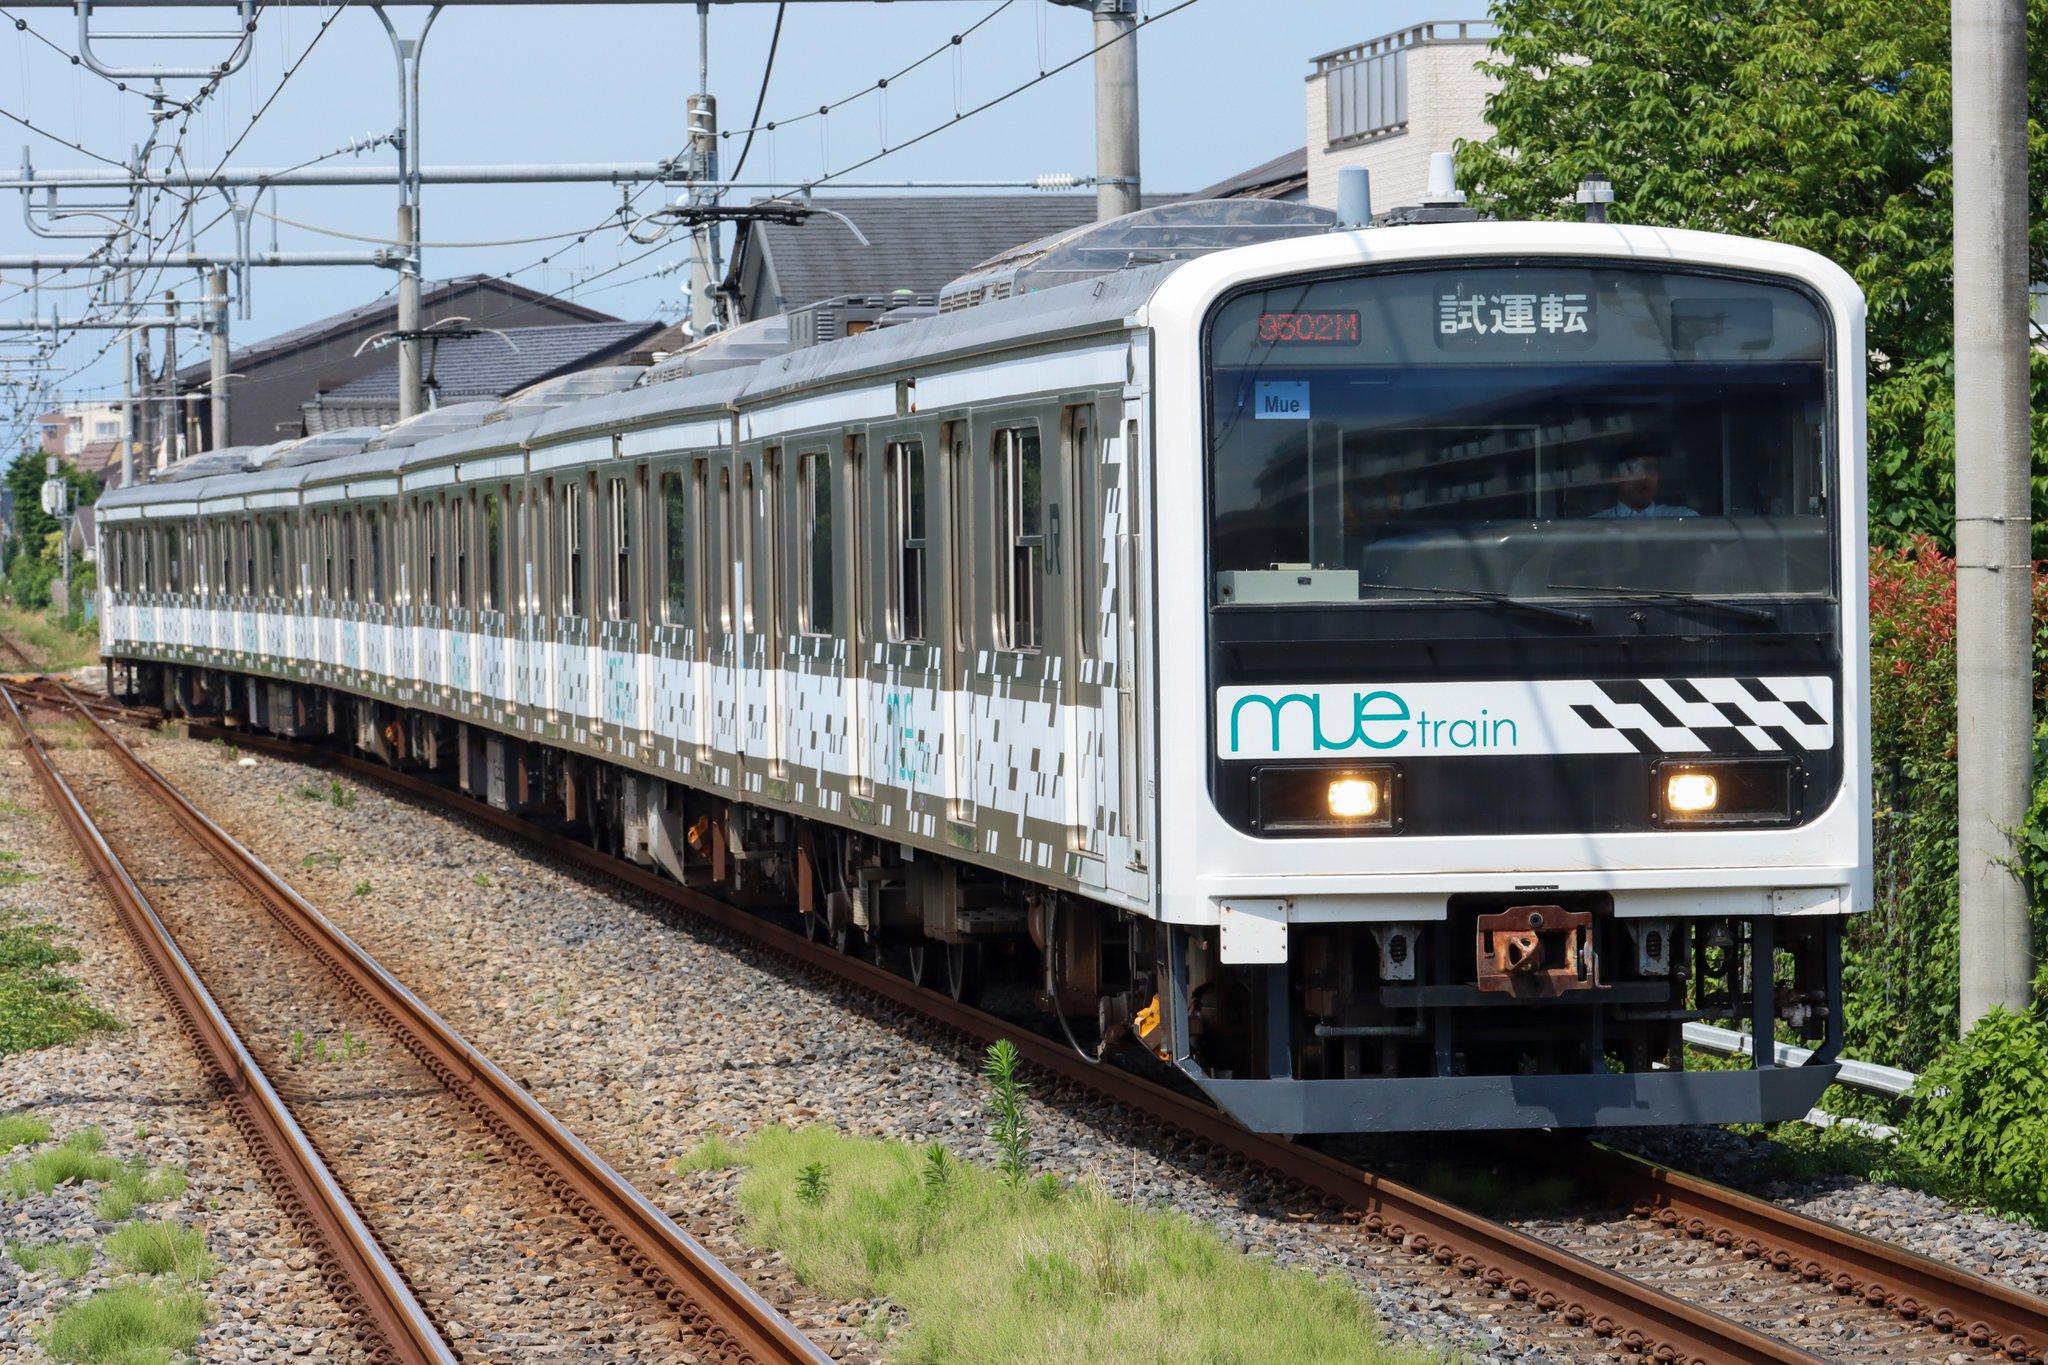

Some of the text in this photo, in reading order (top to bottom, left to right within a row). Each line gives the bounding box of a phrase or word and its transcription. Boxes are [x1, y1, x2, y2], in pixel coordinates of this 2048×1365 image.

[1258, 313, 1358, 341] 9502M
[1438, 293, 1589, 335] 試運転
[1264, 395, 1300, 413] Mue
[1044, 503, 1061, 575] JR
[1230, 690, 1518, 752] mue train
